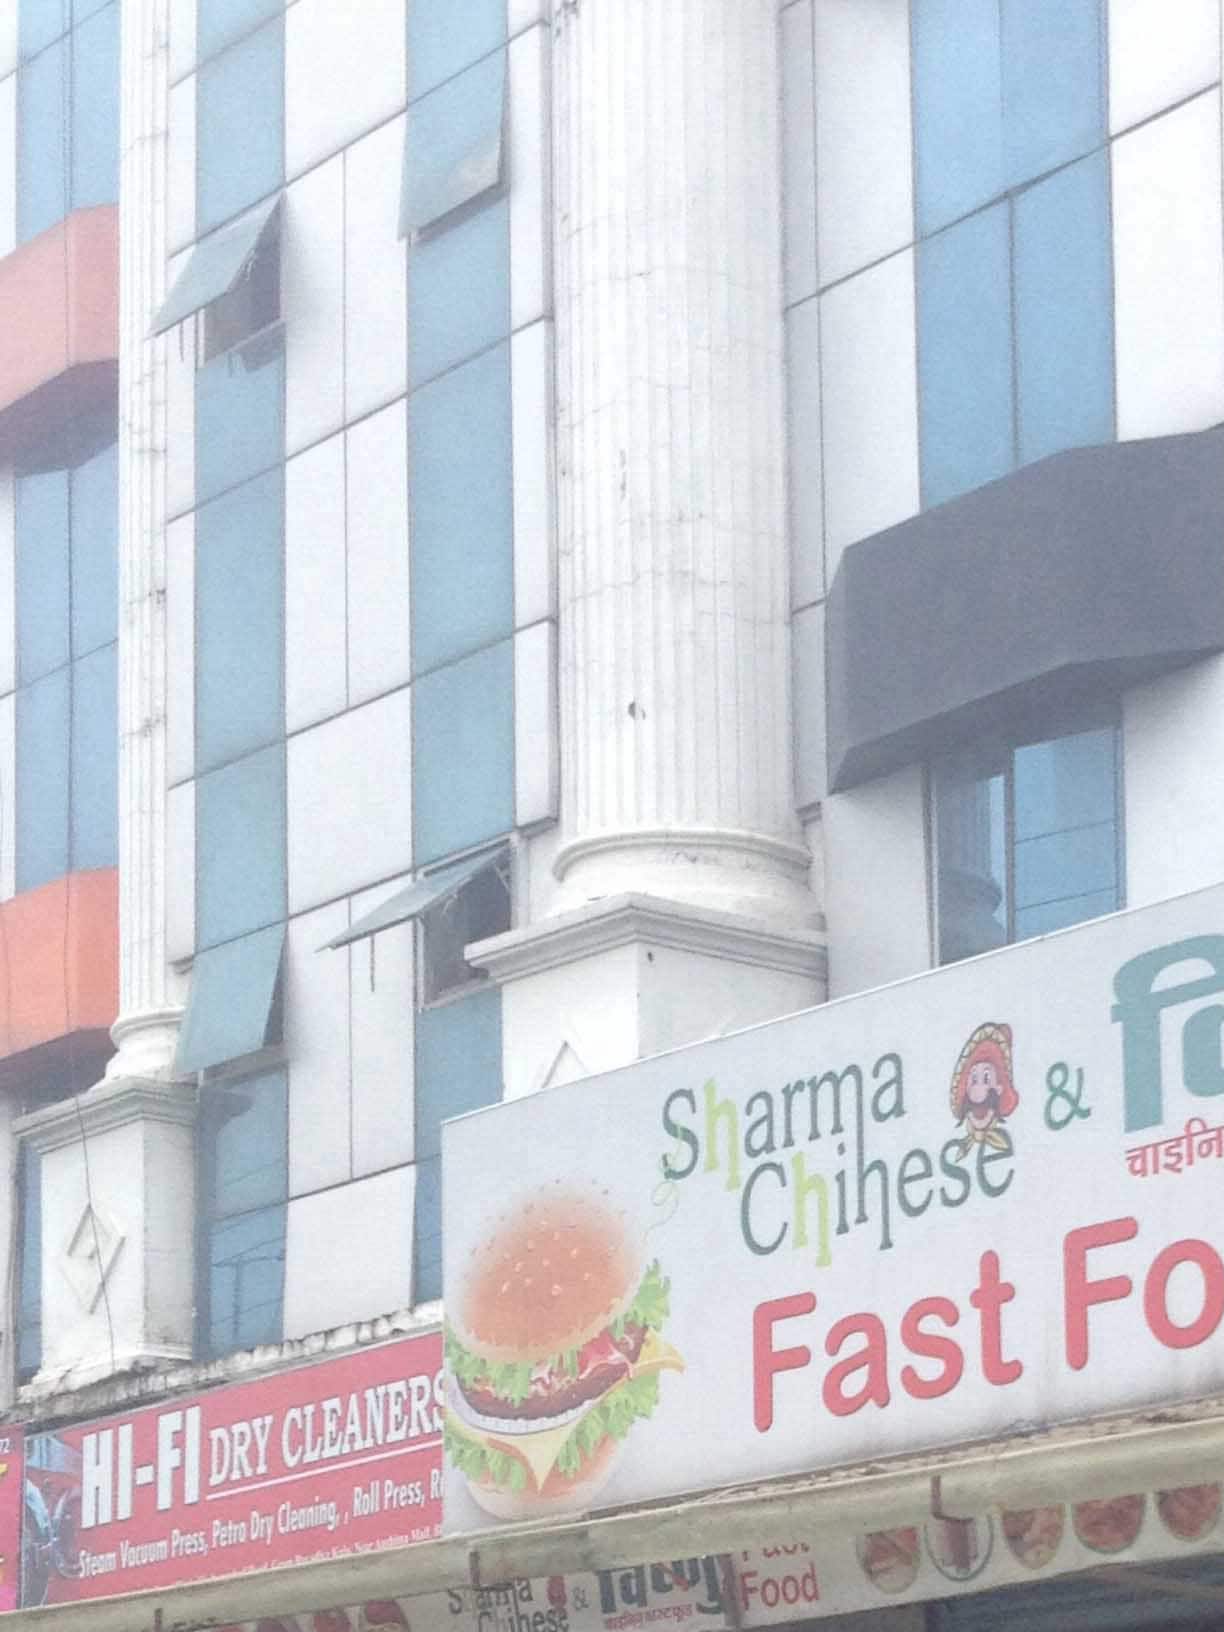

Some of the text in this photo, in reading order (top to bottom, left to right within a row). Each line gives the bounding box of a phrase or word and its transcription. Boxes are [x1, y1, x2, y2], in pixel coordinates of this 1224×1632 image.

[662, 1052, 905, 1192] Sharma
[1044, 1061, 1091, 1131] &
[752, 1249, 1023, 1433] Fast
[81, 1366, 443, 1529] HI-FI DRY CLEANERS
[78, 1549, 117, 1579] Steam
[120, 1538, 168, 1569] Vacuum
[171, 1527, 209, 1559] Press,
[211, 1518, 247, 1549] Petro
[250, 1510, 275, 1545] Dry
[353, 1479, 380, 1517] Roll
[384, 1478, 425, 1511] Press,
[738, 1561, 822, 1612] Food
